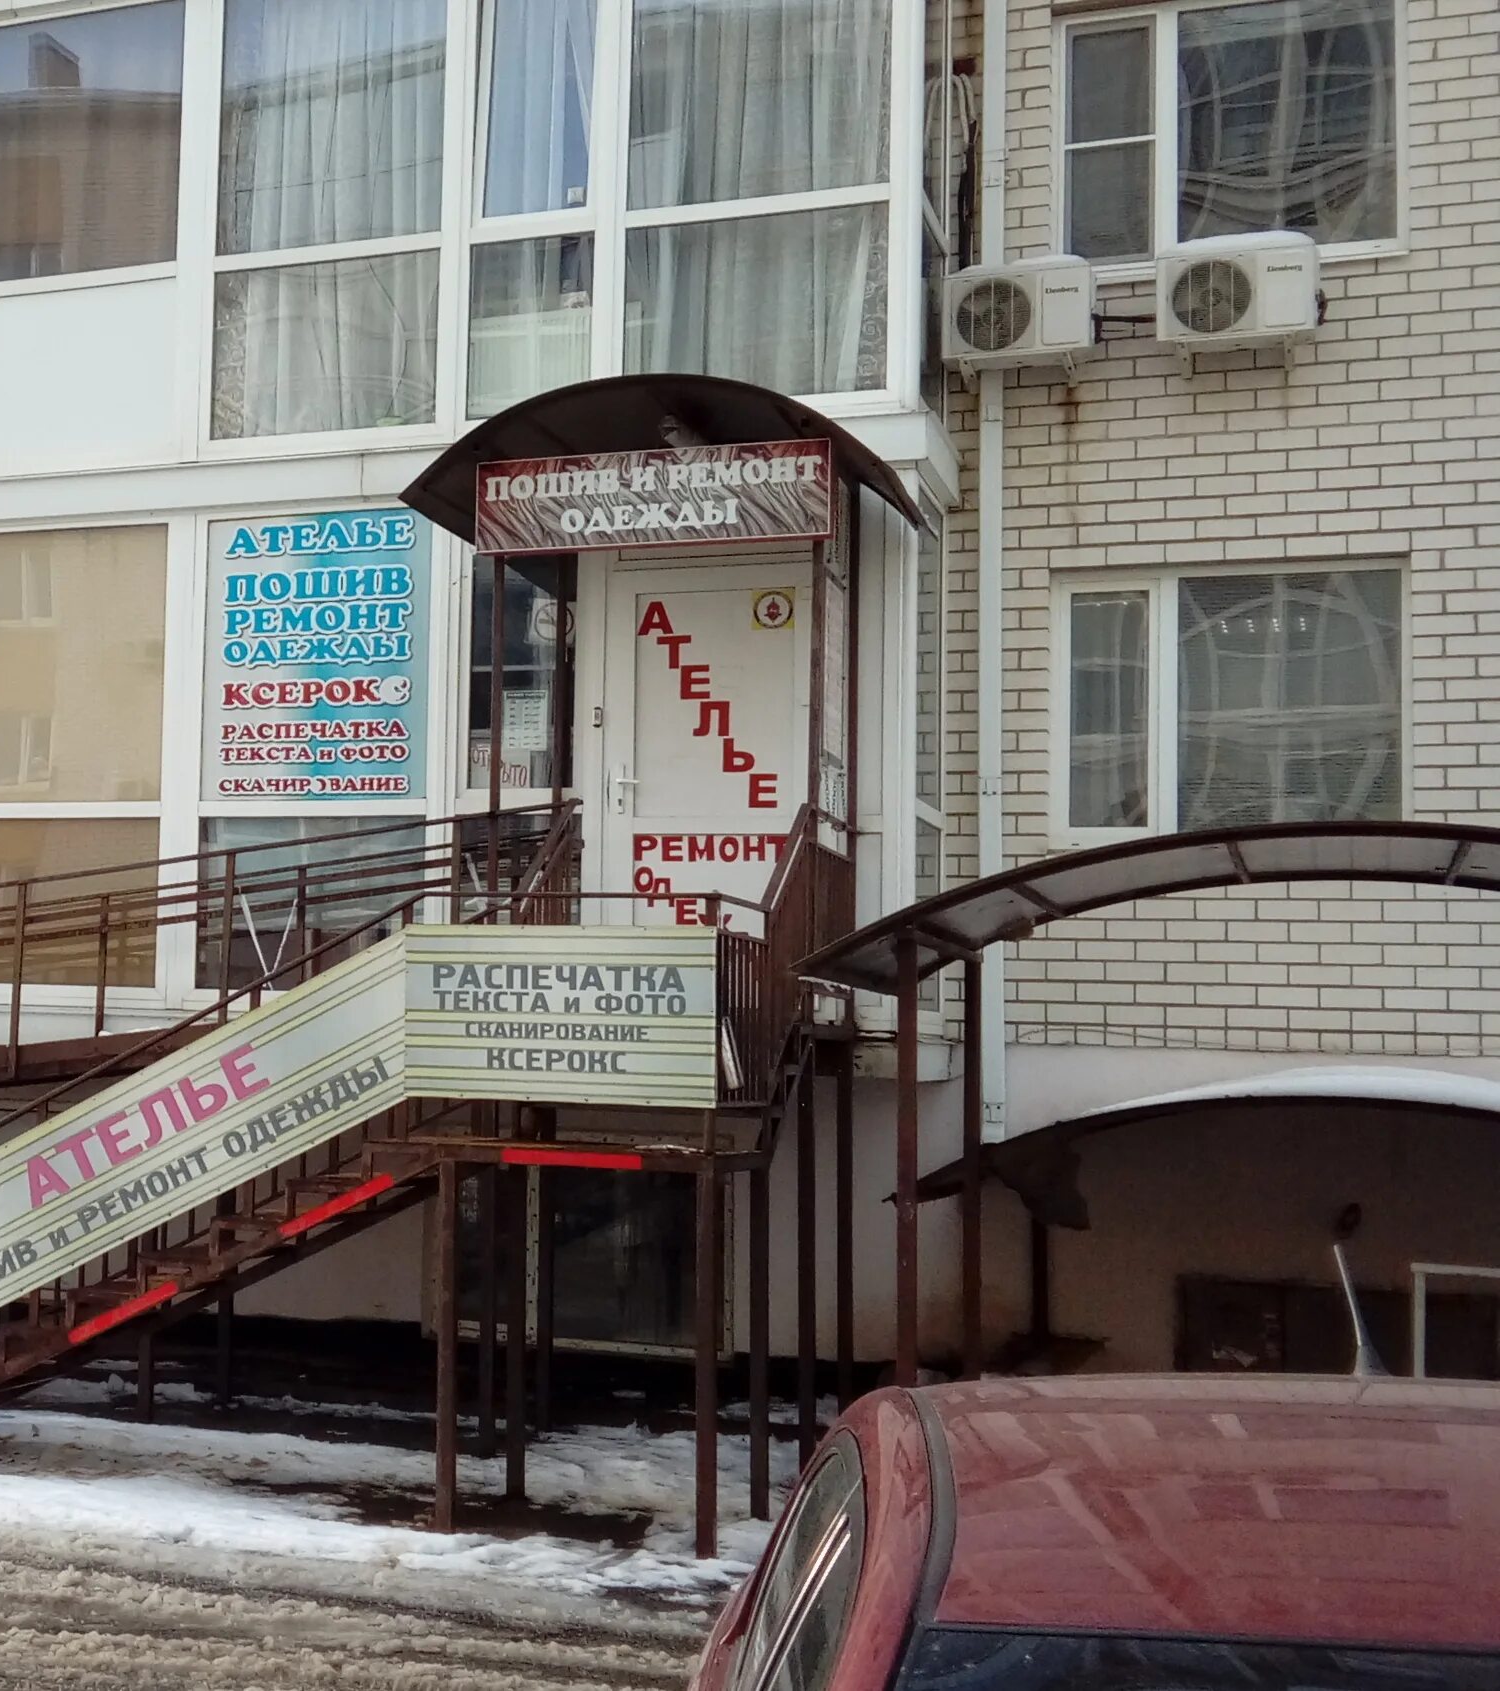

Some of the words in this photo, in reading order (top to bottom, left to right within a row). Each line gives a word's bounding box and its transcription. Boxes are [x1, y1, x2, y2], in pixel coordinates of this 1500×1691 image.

[485, 468, 620, 502] ПОШИВ
[630, 465, 655, 493] И
[668, 455, 822, 490] РЕМОНТ
[560, 499, 740, 535] ОДЕЖДЫ
[227, 518, 413, 556] АТЕЛЬЕ
[225, 566, 411, 603] ПОШИВ
[224, 602, 411, 636] РЕМОНТ
[224, 635, 410, 664] ОДЕЖДЫ
[637, 600, 779, 809] АТЕЛЬЕ
[221, 720, 407, 740] РАСПЕЧАТКА
[220, 746, 313, 762] ТЕКСТА
[340, 744, 407, 761] ФОТО
[471, 746, 528, 788] ОТЫТО
[633, 834, 790, 863] РЕМОНТ
[432, 963, 686, 993] РАСПЕЧАТКА
[433, 990, 550, 1014] ТЕКСТА
[594, 993, 687, 1016] ФОТО
[465, 1020, 650, 1042] СКАНИРОВАНИЕ
[487, 1048, 627, 1074] КСЕРОКС
[24, 1043, 271, 1210] АТЕЛЬЕ
[75, 1144, 209, 1238] РЕМОНТ
[221, 1055, 391, 1159] ОДЕЖДЫ
